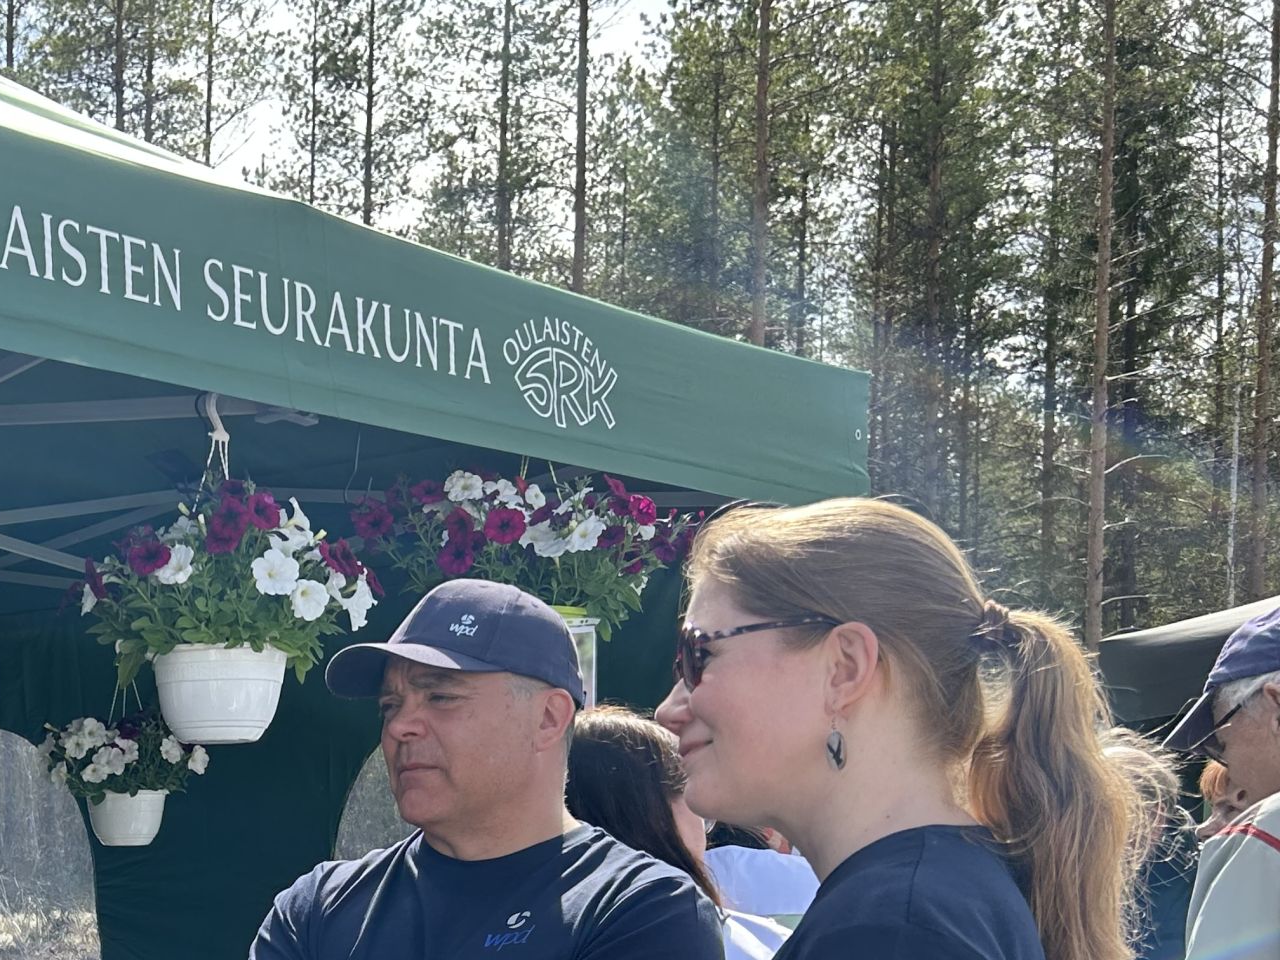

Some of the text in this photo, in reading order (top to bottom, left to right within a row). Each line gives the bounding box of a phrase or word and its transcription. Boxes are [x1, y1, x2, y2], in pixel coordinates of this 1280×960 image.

[205, 258, 492, 384] SEURAKUNTA
[503, 316, 607, 379] OULAISTEN
[514, 346, 618, 430] SRK
